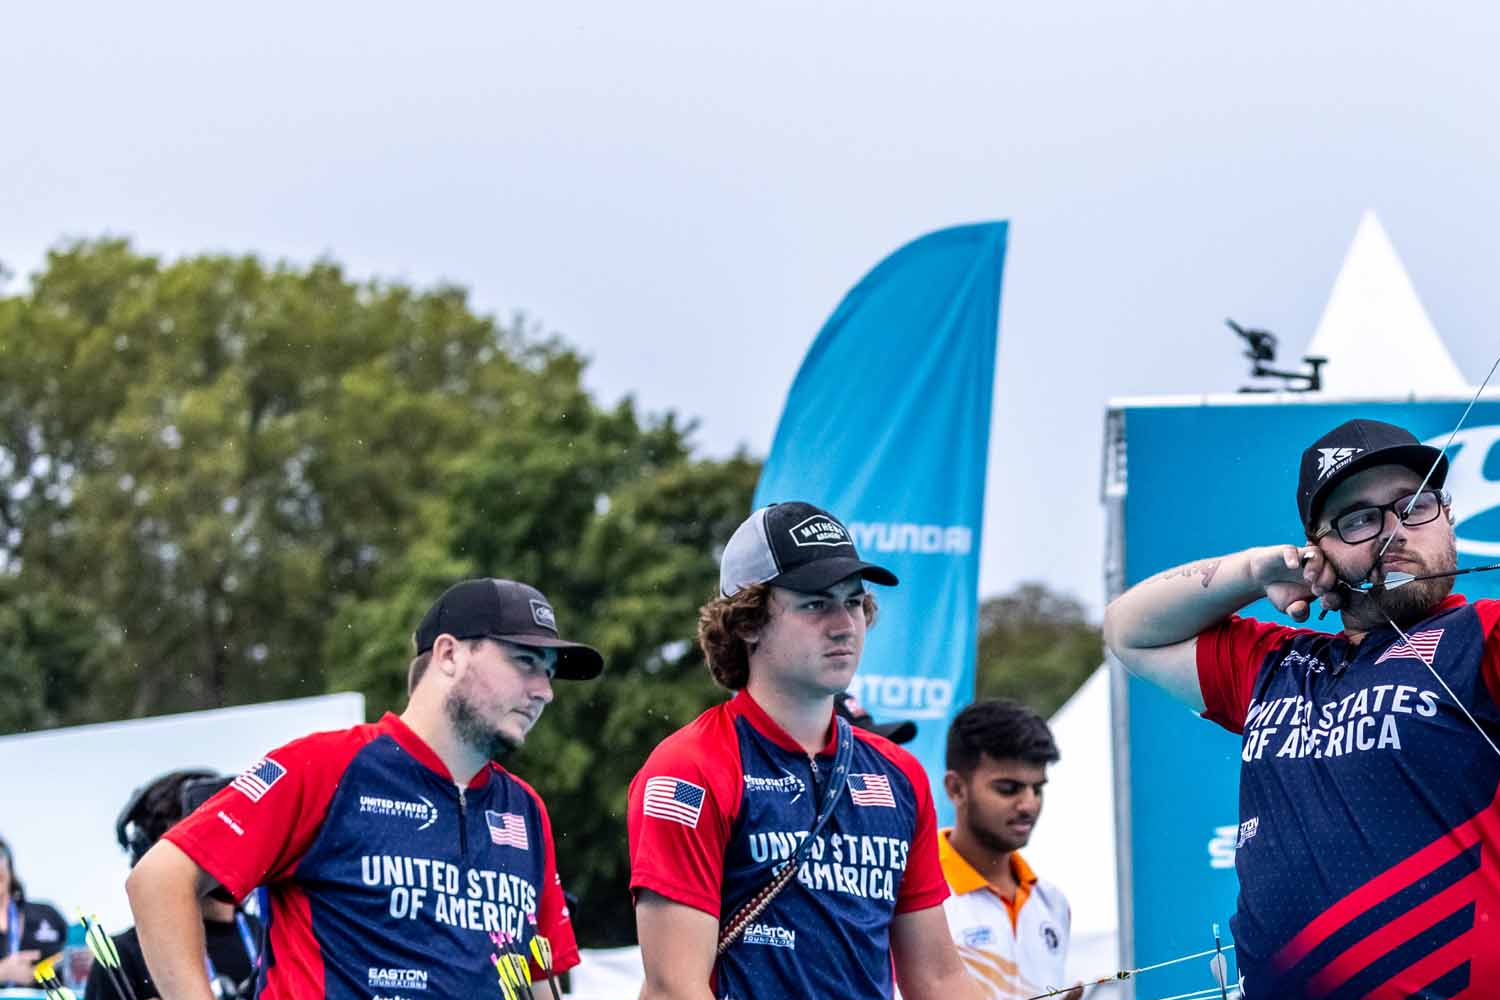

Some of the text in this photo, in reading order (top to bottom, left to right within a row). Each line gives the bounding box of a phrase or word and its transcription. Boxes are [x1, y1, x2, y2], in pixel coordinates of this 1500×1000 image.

[852, 523, 972, 554] YUNDAI
[1318, 685, 1441, 731] STATES
[1242, 727, 1277, 763] OF
[360, 796, 428, 813] UNITED STATES
[830, 832, 909, 871] STATES
[361, 856, 536, 914] UNITED STATES
[797, 861, 895, 901] AMERICA
[389, 887, 427, 920] OF
[744, 924, 796, 941] EASTON
[368, 967, 428, 982] EASTON
